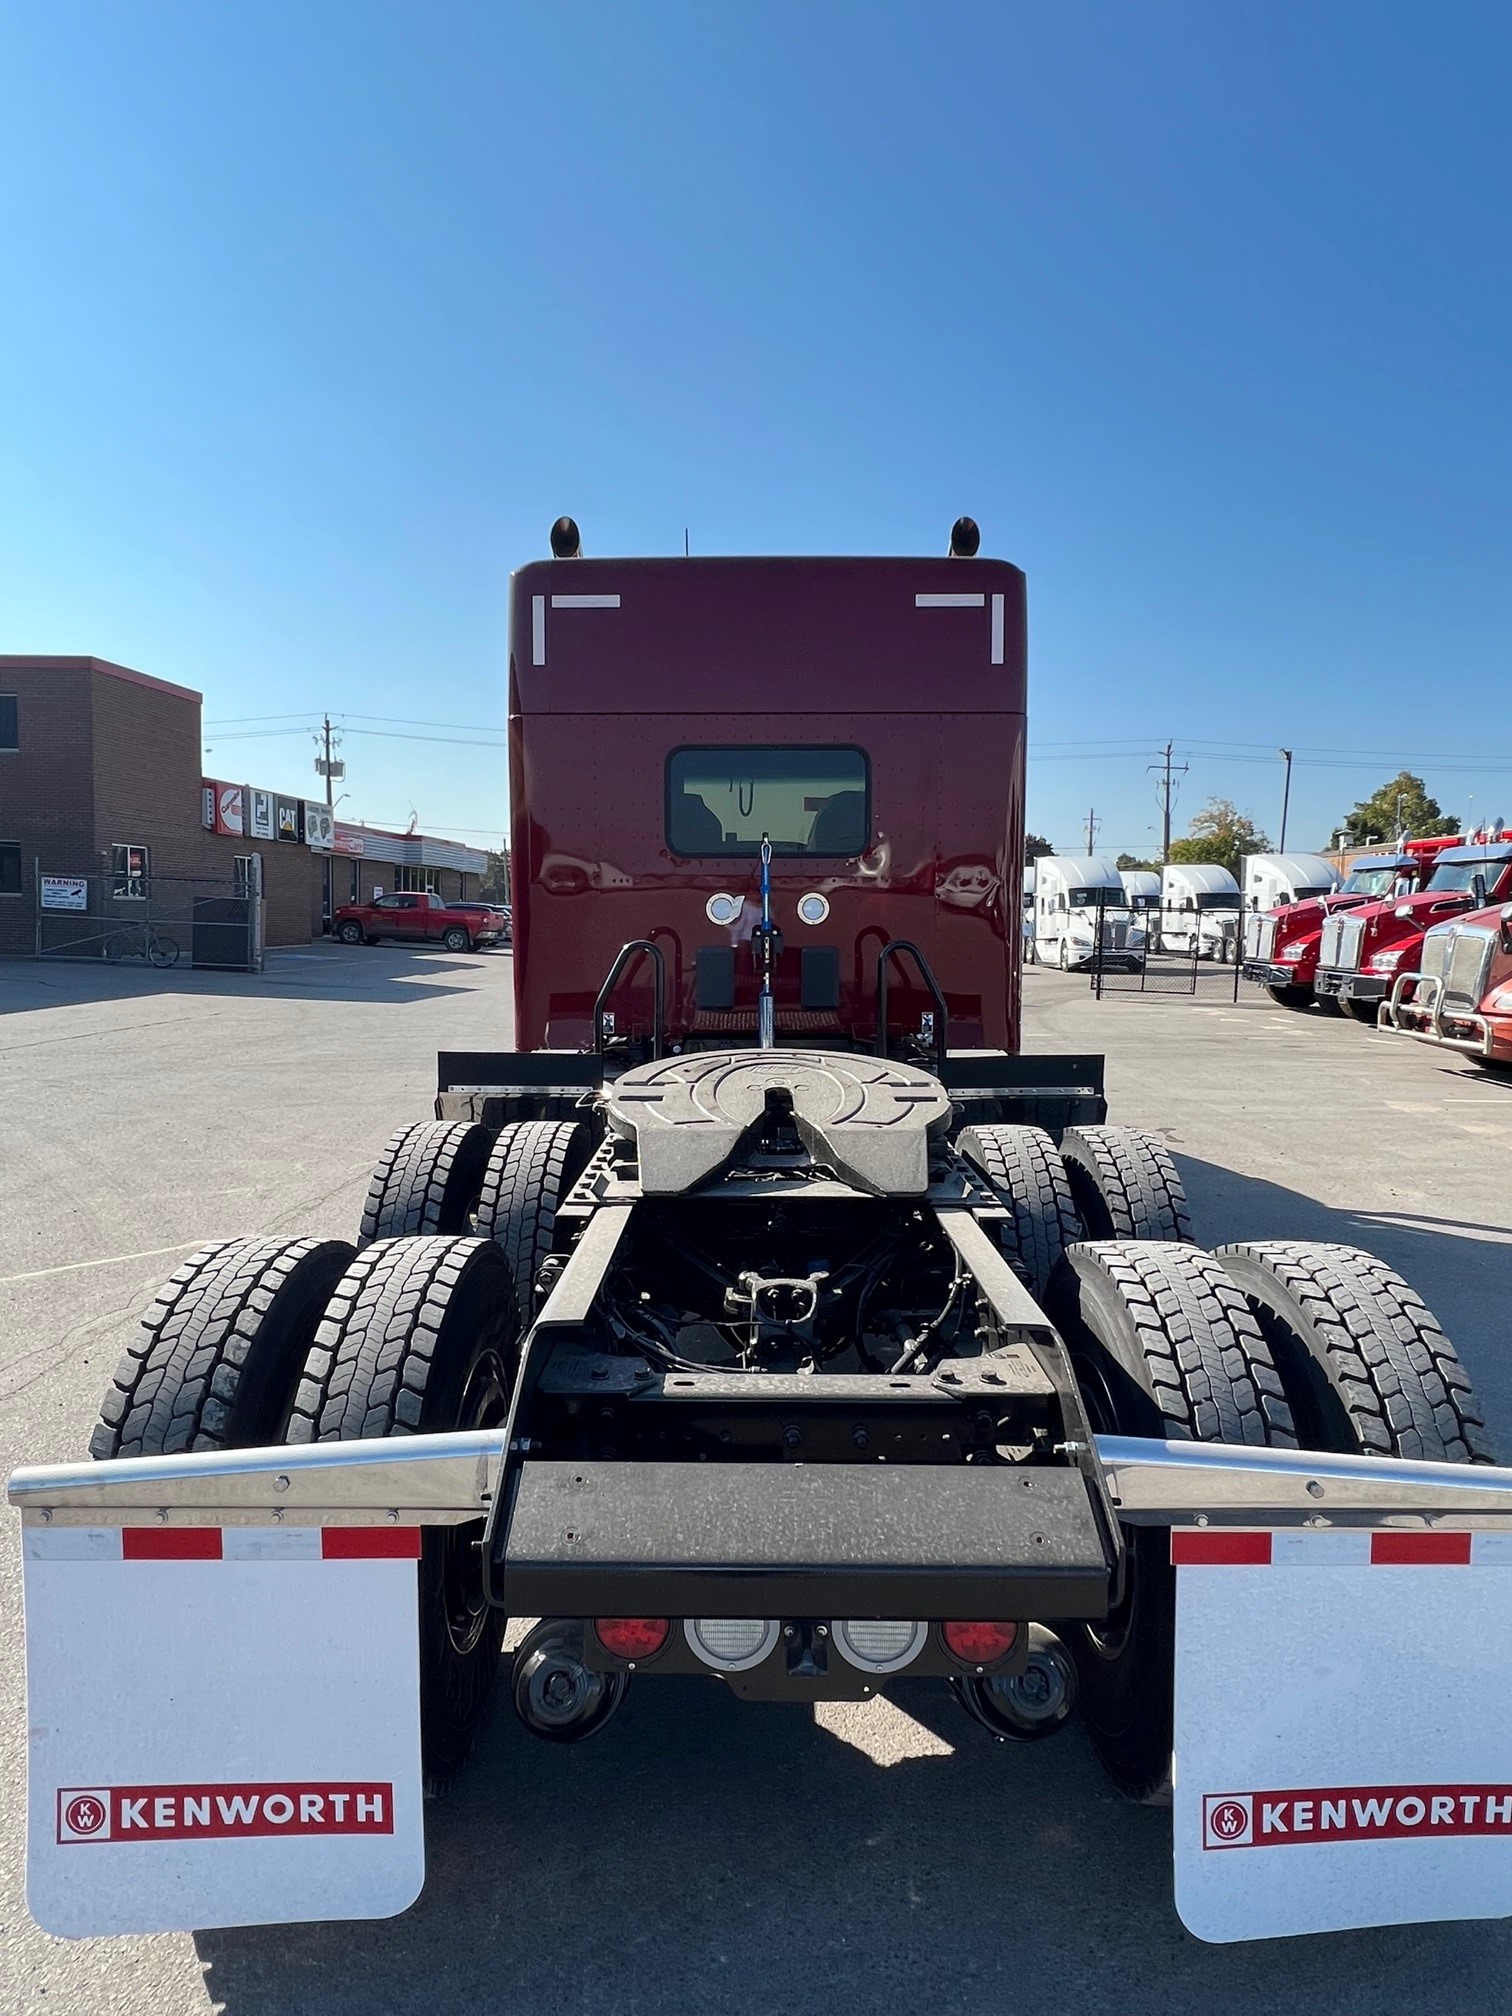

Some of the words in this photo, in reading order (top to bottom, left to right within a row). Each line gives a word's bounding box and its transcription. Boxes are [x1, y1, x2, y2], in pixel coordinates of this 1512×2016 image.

[279, 807, 296, 830] CAT
[43, 879, 85, 887] WARNING
[121, 1794, 383, 1829] KENWORTH
[1262, 1796, 1512, 1833] KENWORTH
